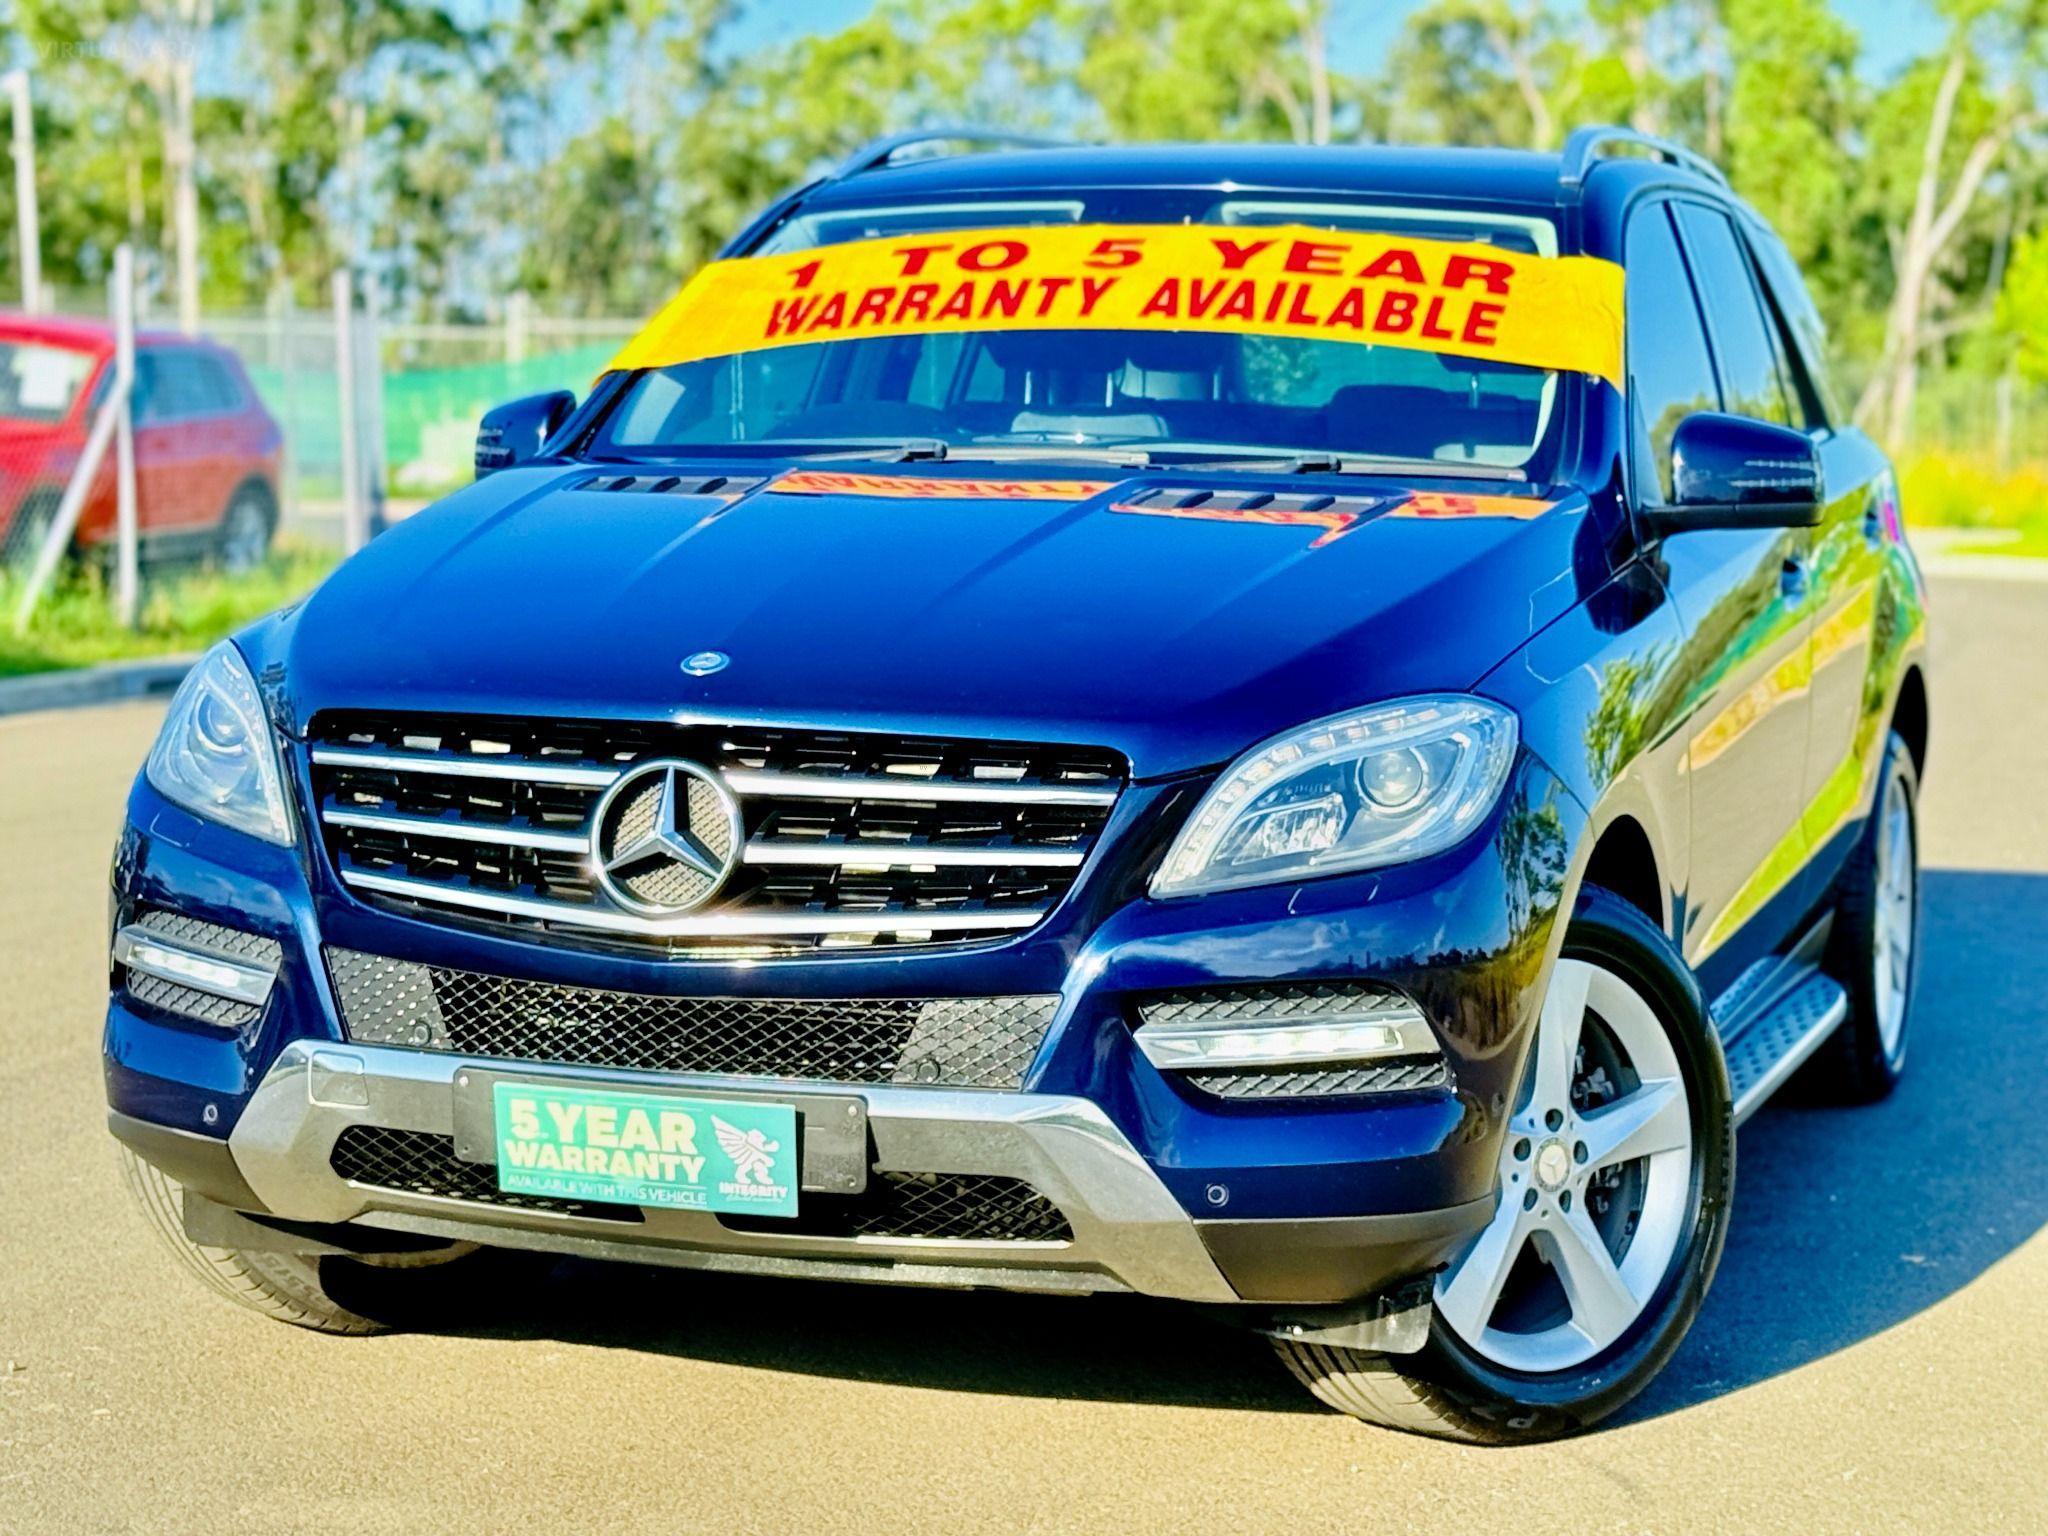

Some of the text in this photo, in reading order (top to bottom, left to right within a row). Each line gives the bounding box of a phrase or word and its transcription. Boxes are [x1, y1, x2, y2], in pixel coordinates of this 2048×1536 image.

[789, 239, 1516, 296] 1 TO 5 YEAR
[763, 276, 1506, 347] WARRANTY AVAILABLE
[510, 1098, 699, 1155] 5 YEAR
[504, 1139, 706, 1184] WARRANTY
[508, 1174, 577, 1193] AVAILABLE
[578, 1180, 615, 1197] WITH
[617, 1184, 648, 1201] THIS
[649, 1187, 707, 1204] VEHICLE
[719, 1181, 788, 1200] INTEGRITY
